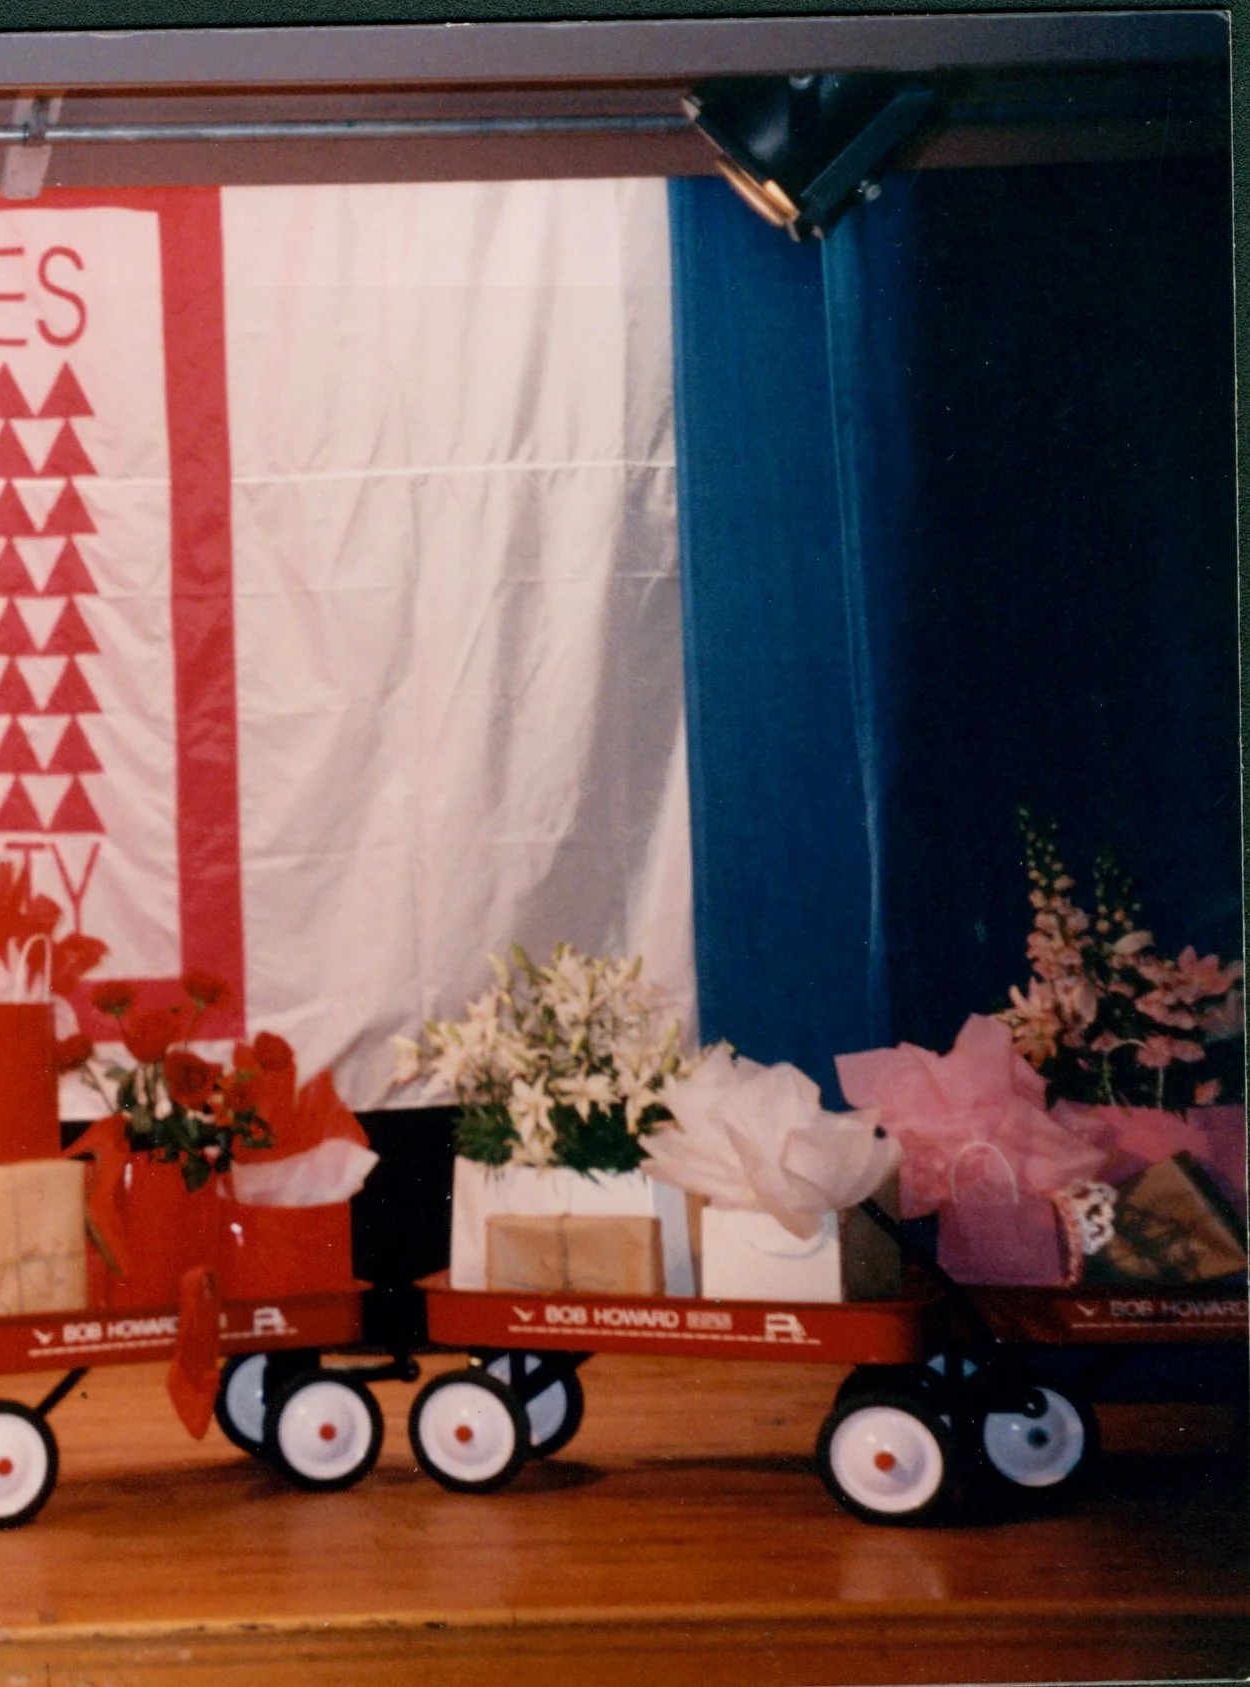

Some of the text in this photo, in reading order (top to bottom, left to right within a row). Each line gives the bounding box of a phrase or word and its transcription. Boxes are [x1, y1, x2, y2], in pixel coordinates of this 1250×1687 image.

[544, 1303, 588, 1326] BOB
[593, 1306, 680, 1330] HOWARD
[1109, 1299, 1248, 1318] BOB HOWARD
[62, 1321, 103, 1345] BOB
